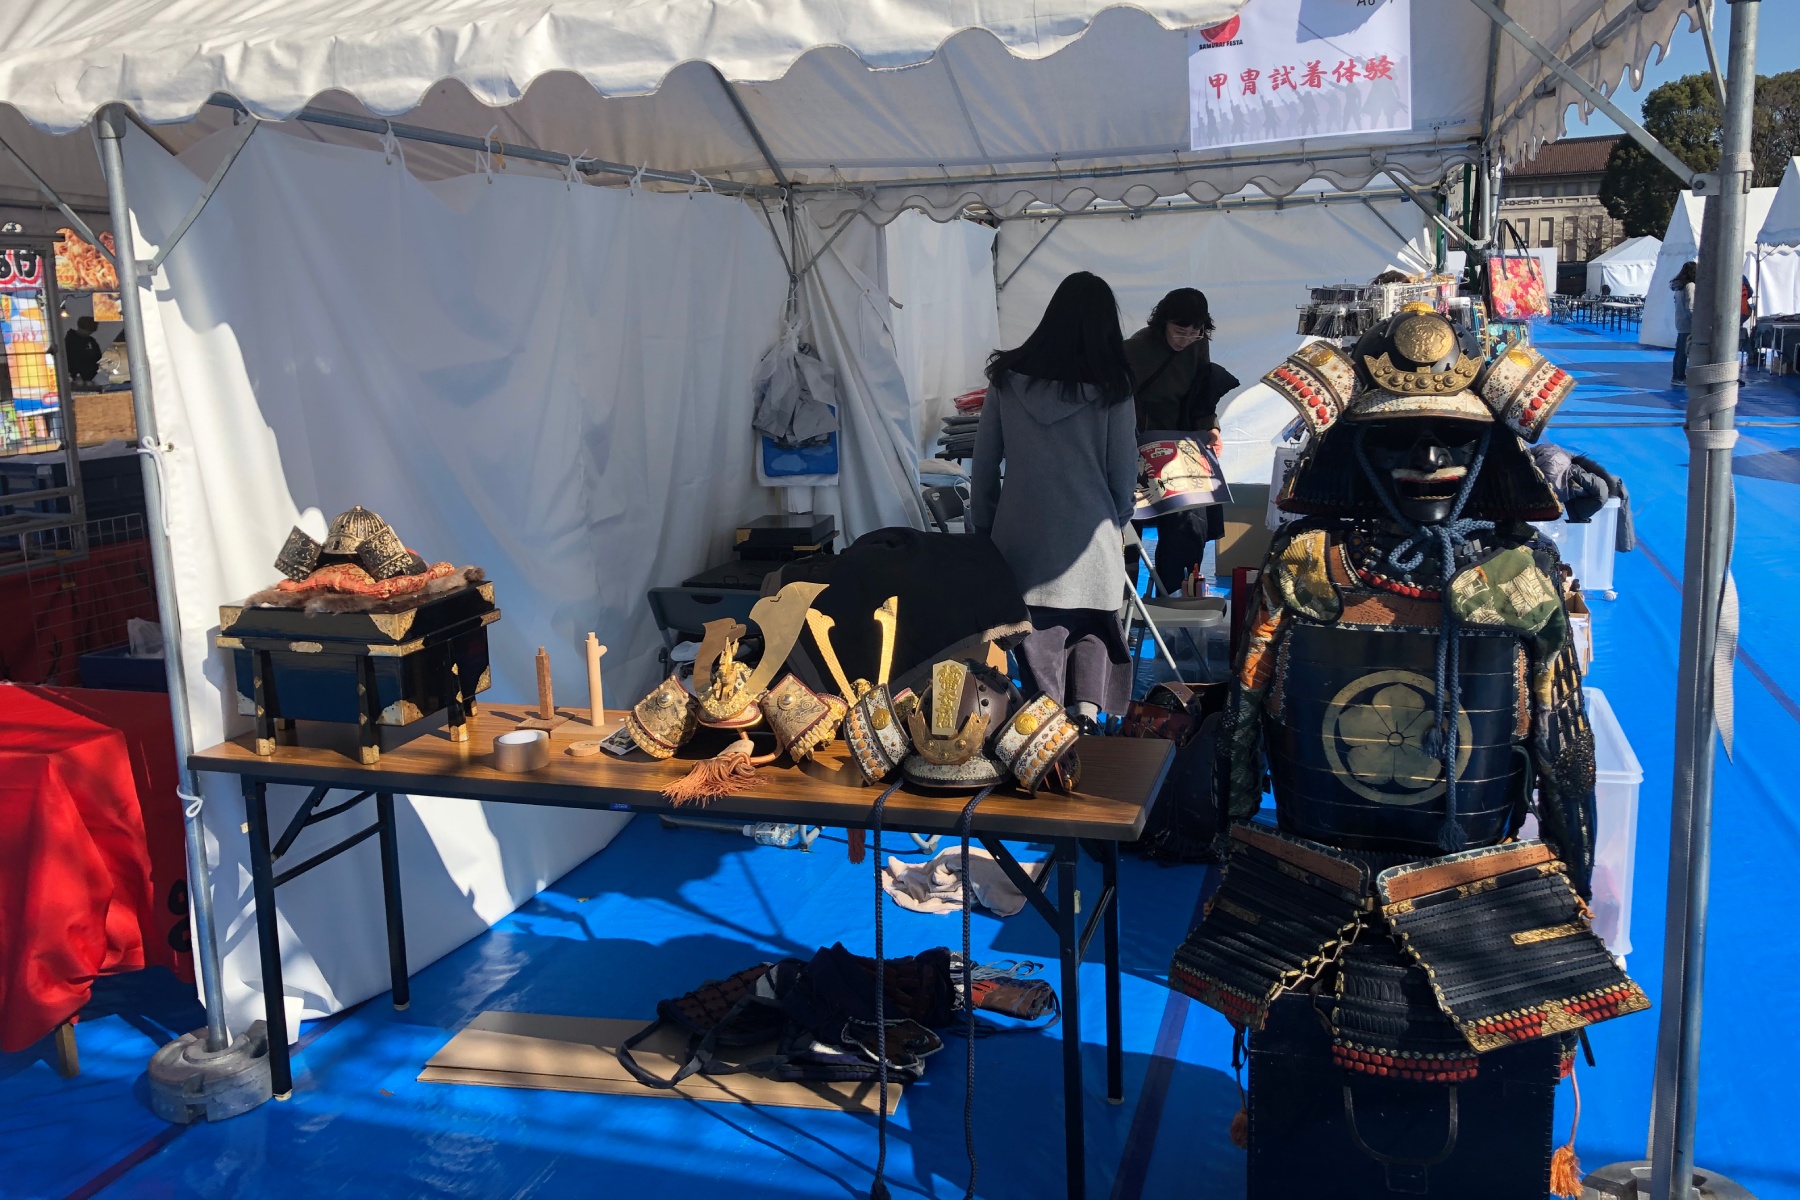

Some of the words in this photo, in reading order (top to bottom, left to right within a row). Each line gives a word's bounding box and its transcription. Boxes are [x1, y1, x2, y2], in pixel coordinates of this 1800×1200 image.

[1199, 42, 1225, 50] SAMURAI
[1227, 39, 1243, 47] FESTA
[1208, 55, 1395, 99] 甲冑試着体験
[12, 330, 39, 342] DRY
